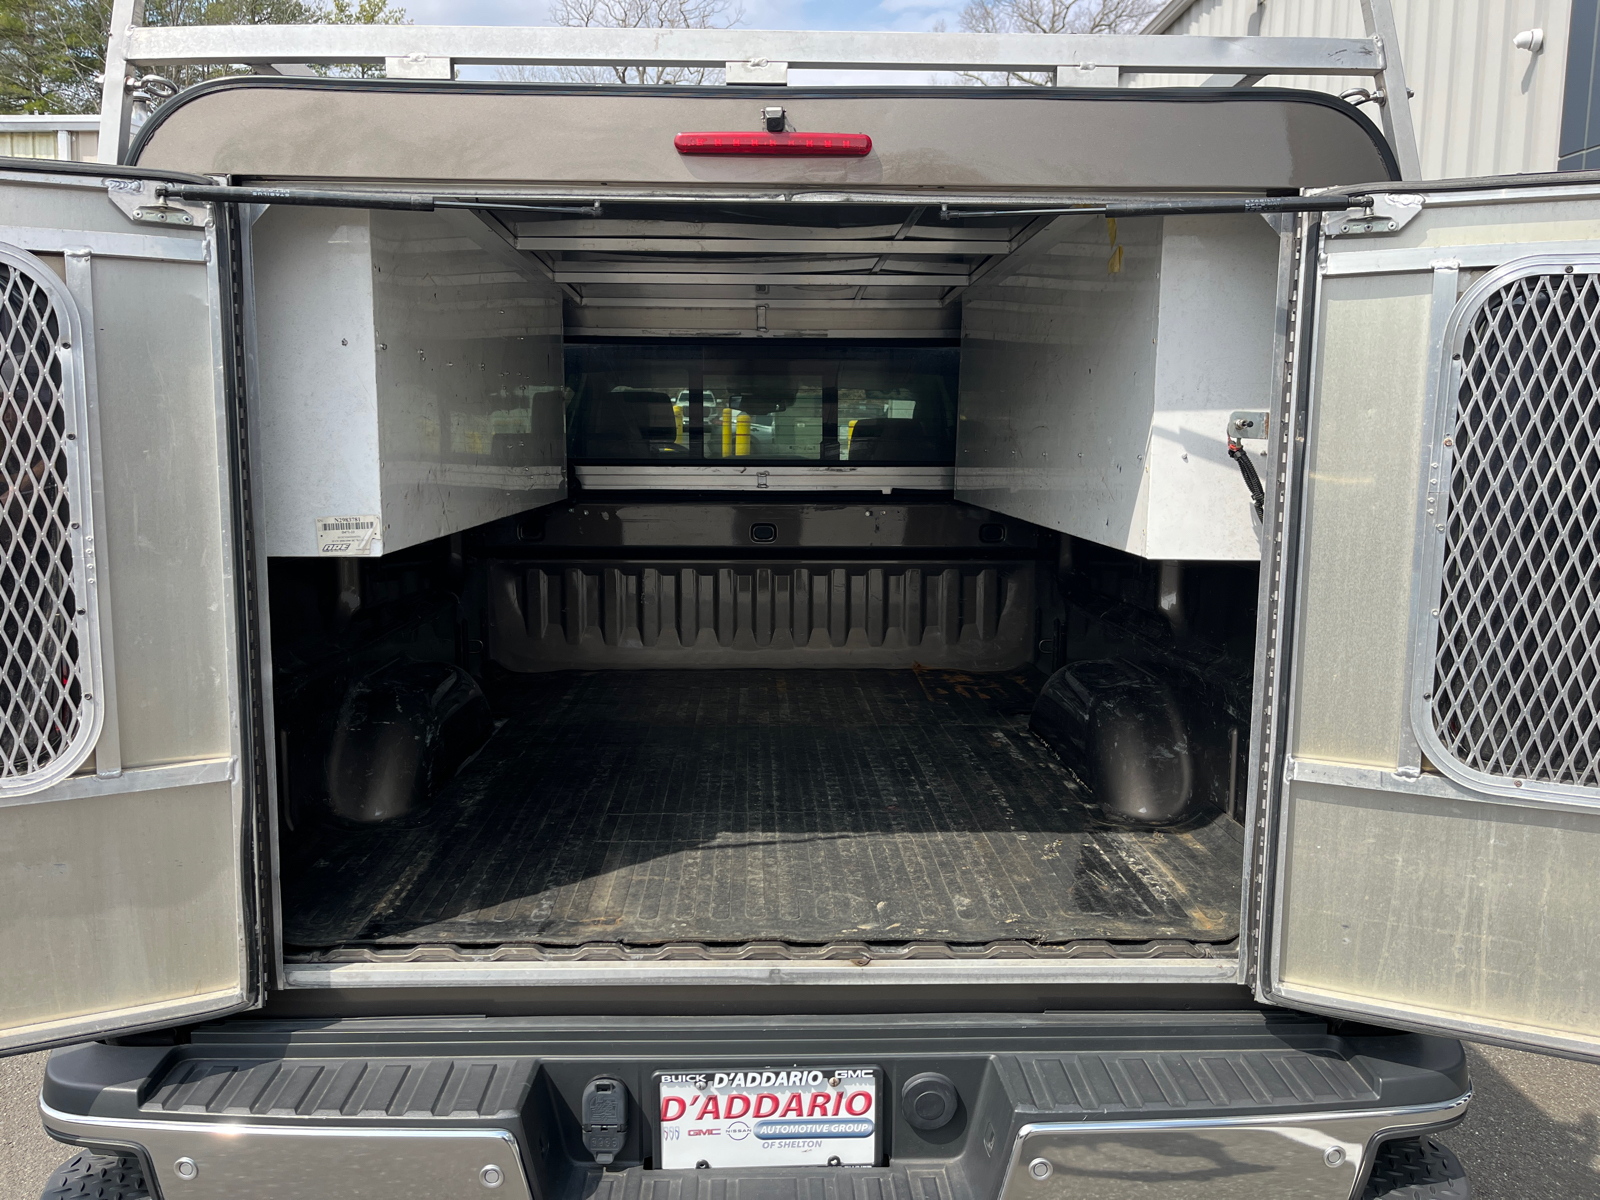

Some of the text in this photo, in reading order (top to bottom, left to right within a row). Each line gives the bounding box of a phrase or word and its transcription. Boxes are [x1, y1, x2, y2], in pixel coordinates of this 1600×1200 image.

[661, 1070, 873, 1089] BUICK D'ADDARIO GMC
[660, 1090, 873, 1122] D'ADDARIO
[688, 1128, 721, 1136] GMC
[760, 1123, 869, 1134] AUTOMOTIVE GROUP
[762, 1140, 822, 1149] OF SHELTON
